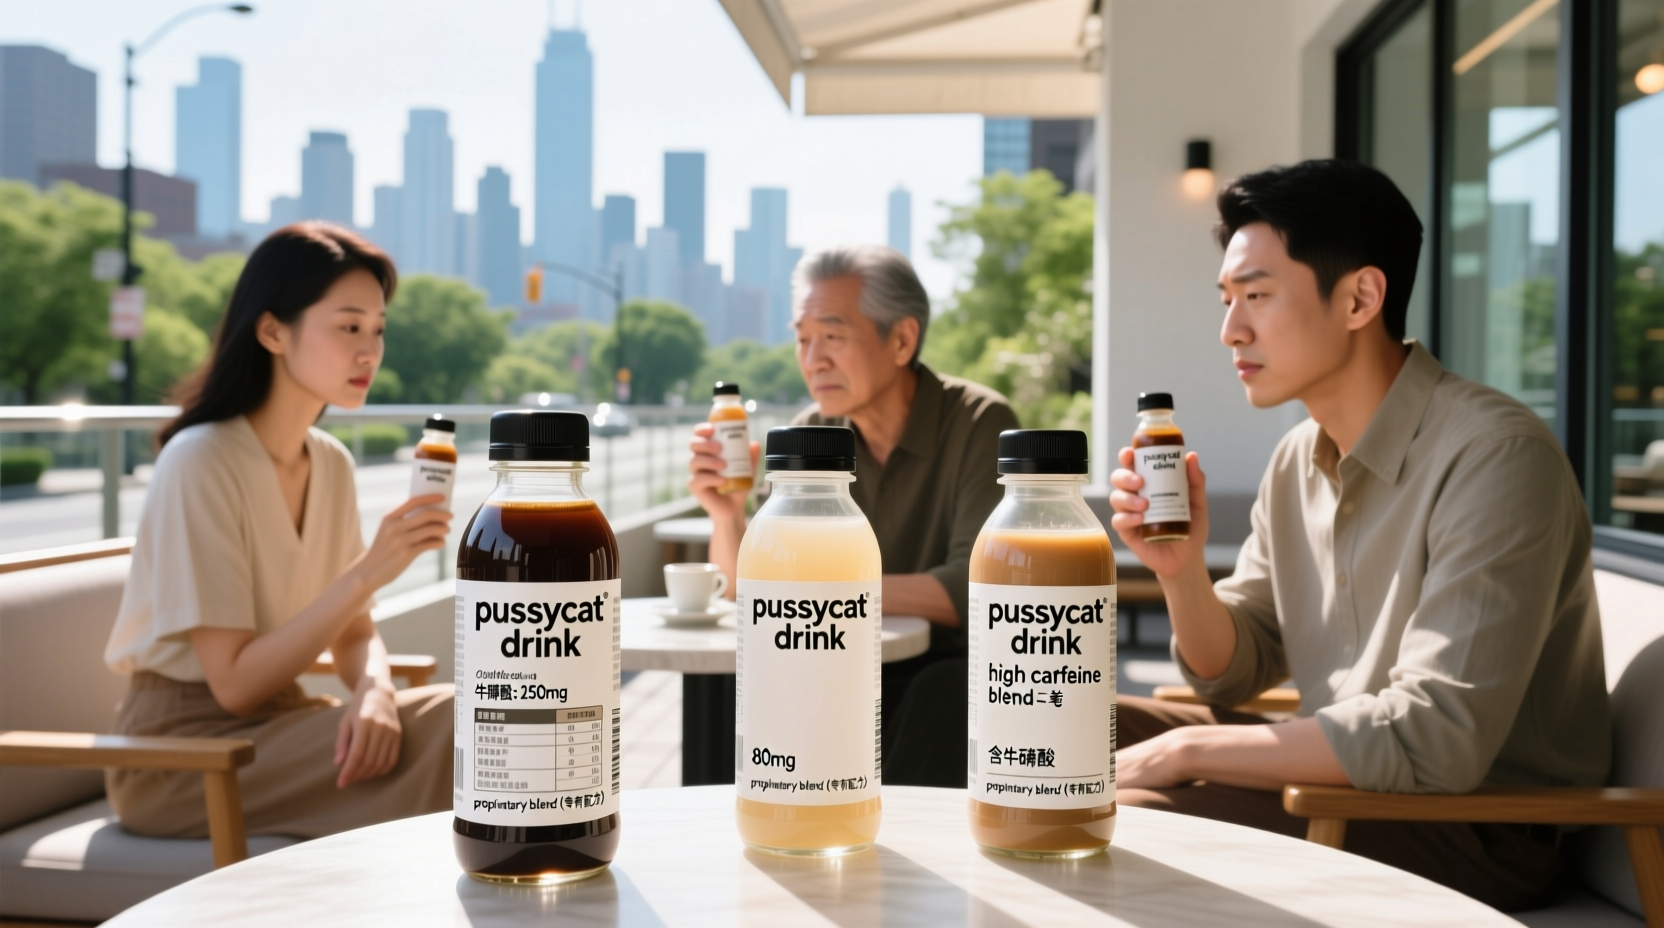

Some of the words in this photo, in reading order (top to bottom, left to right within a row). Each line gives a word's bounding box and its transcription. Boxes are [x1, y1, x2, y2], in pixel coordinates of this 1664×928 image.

[475, 595, 604, 632] pussycat
[753, 593, 867, 627] pussycat
[988, 599, 1104, 632] pussycat
[500, 628, 582, 658] drink
[774, 623, 846, 650] drink
[1011, 627, 1082, 655] drink
[988, 662, 1026, 687] high
[520, 684, 568, 703] 250mg
[988, 686, 1034, 706] blend
[752, 747, 796, 772] 80mg
